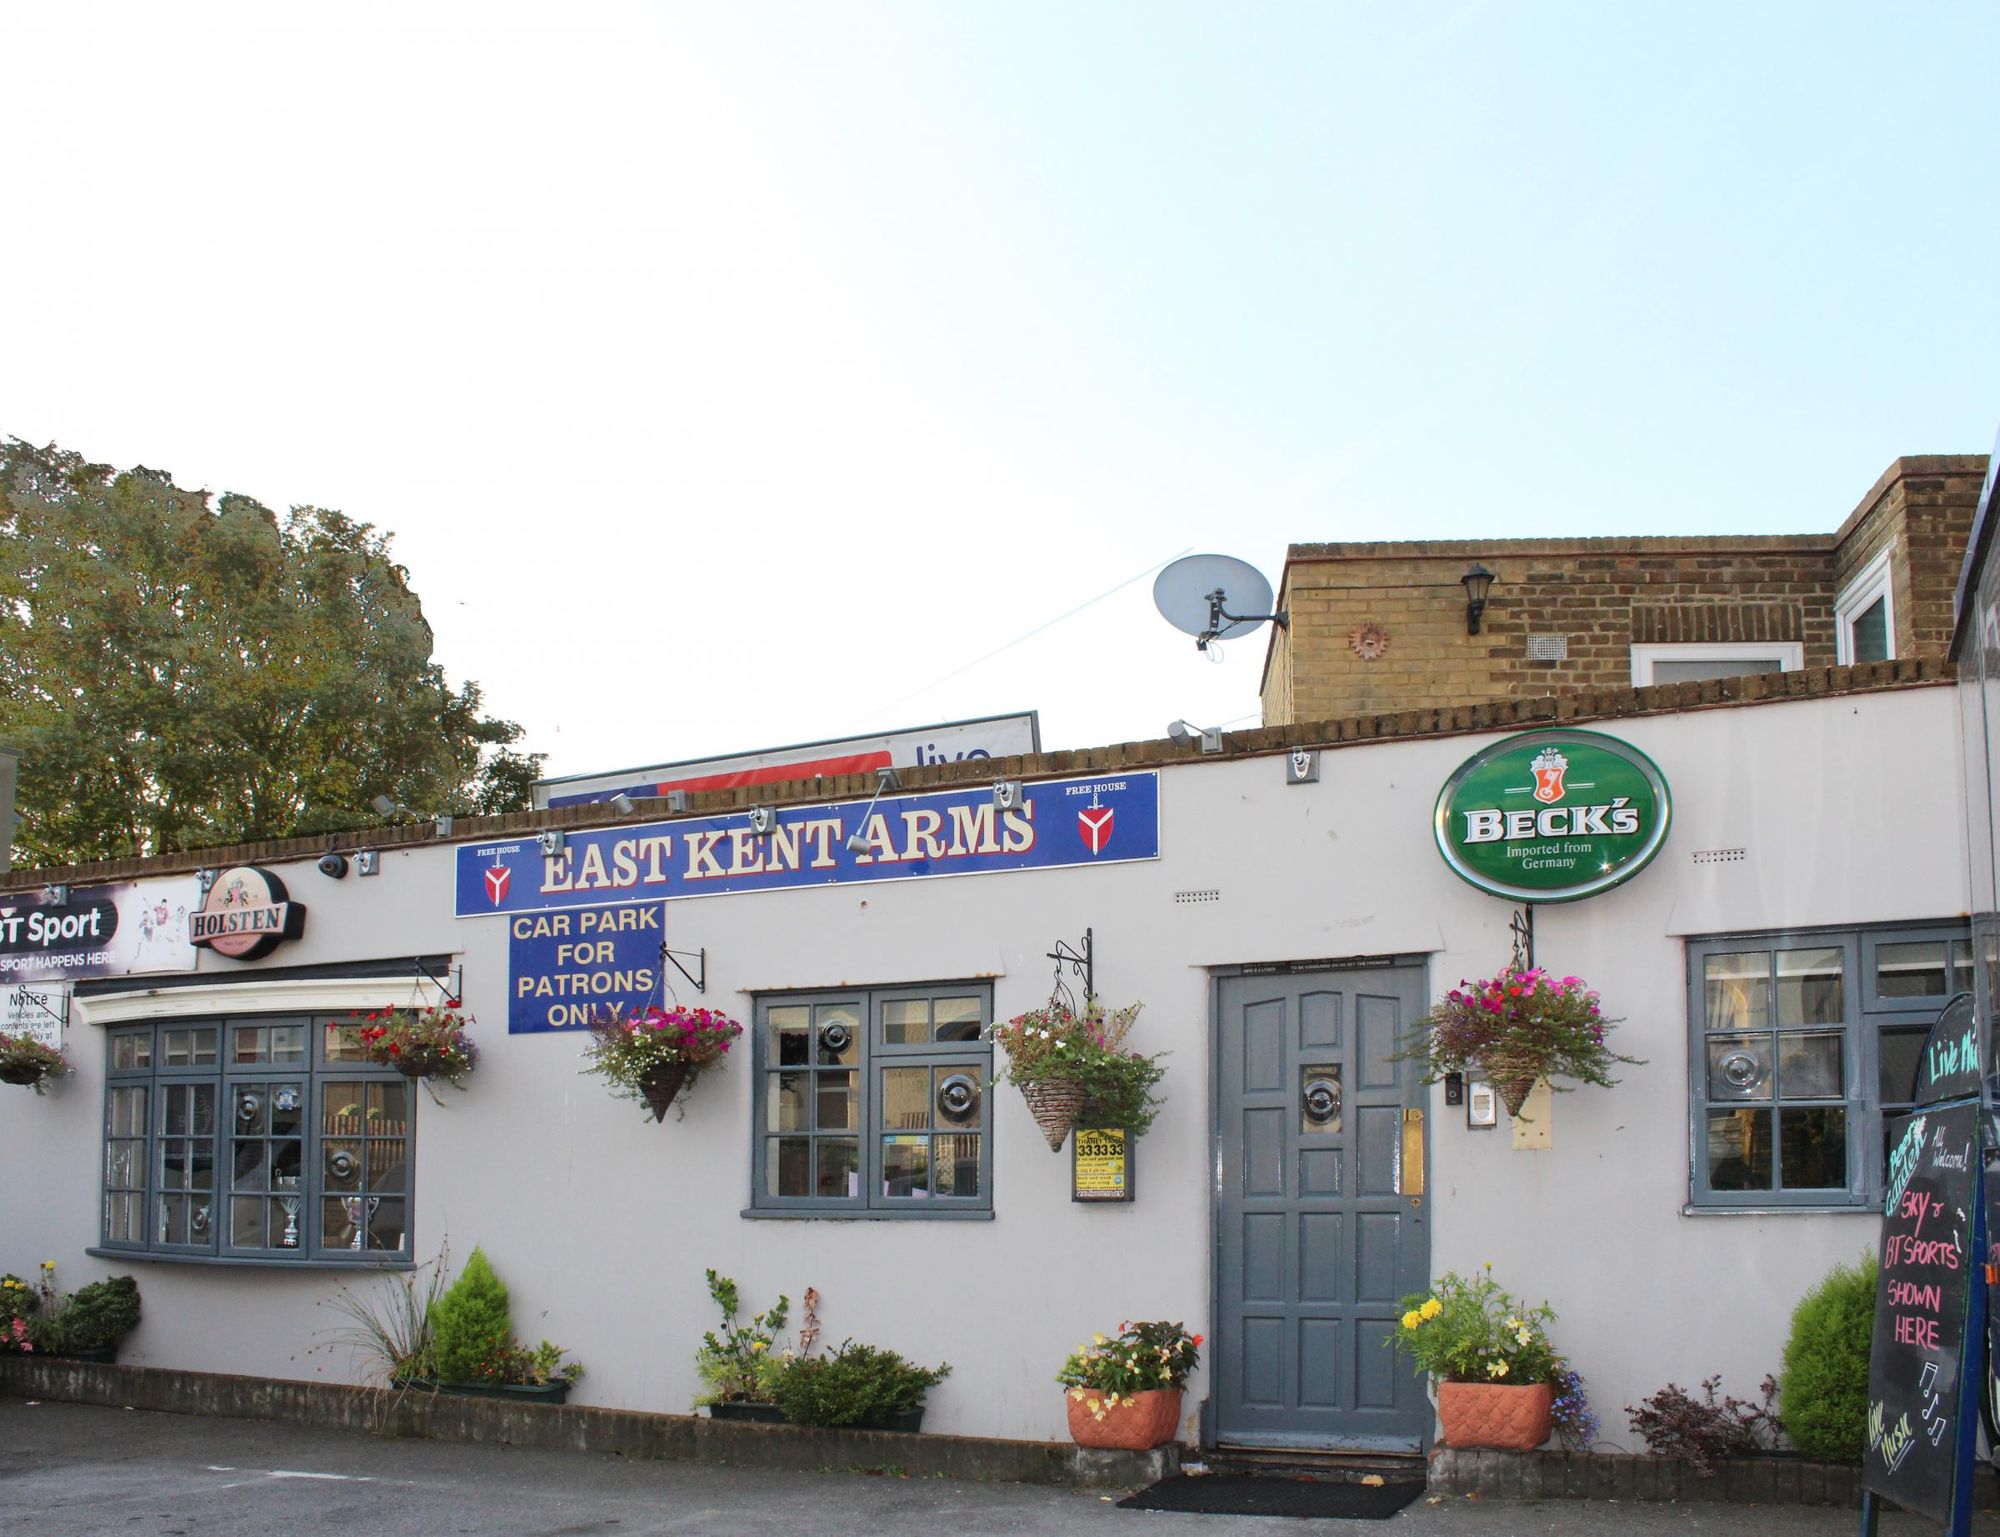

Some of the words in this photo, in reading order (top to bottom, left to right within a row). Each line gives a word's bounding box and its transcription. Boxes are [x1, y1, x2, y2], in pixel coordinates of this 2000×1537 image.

[1065, 784, 1092, 796] FREE
[1093, 781, 1127, 793] HOUSE
[477, 847, 497, 857] FREE
[497, 845, 521, 855] HOUSE
[540, 835, 672, 894] EAST
[683, 818, 842, 881] KENT
[855, 799, 1036, 866] ARMS
[1506, 843, 1560, 858] Imported
[1563, 842, 1592, 853] from
[1522, 857, 1577, 870] Germany
[0, 917, 25, 944] T
[27, 906, 101, 947] Sport
[193, 907, 281, 938] HOLSTEN
[513, 913, 571, 940] CAR
[580, 906, 659, 934] PARK
[0, 956, 36, 972] SPORT
[36, 953, 85, 969] HAPPENS
[87, 950, 119, 965] HERE
[557, 941, 615, 966] FOR
[10, 992, 48, 1006] Notice
[517, 968, 654, 999] PATRONS
[1, 1021, 29, 1031] contents
[44, 1020, 56, 1029] left
[547, 1001, 624, 1027] ONLY
[1929, 1040, 1959, 1086] Live
[1901, 1190, 1931, 1238] SKY
[1903, 1236, 1959, 1270] SPORTS
[1887, 1279, 1942, 1313] SHOWN
[1895, 1314, 1941, 1351] HERE
